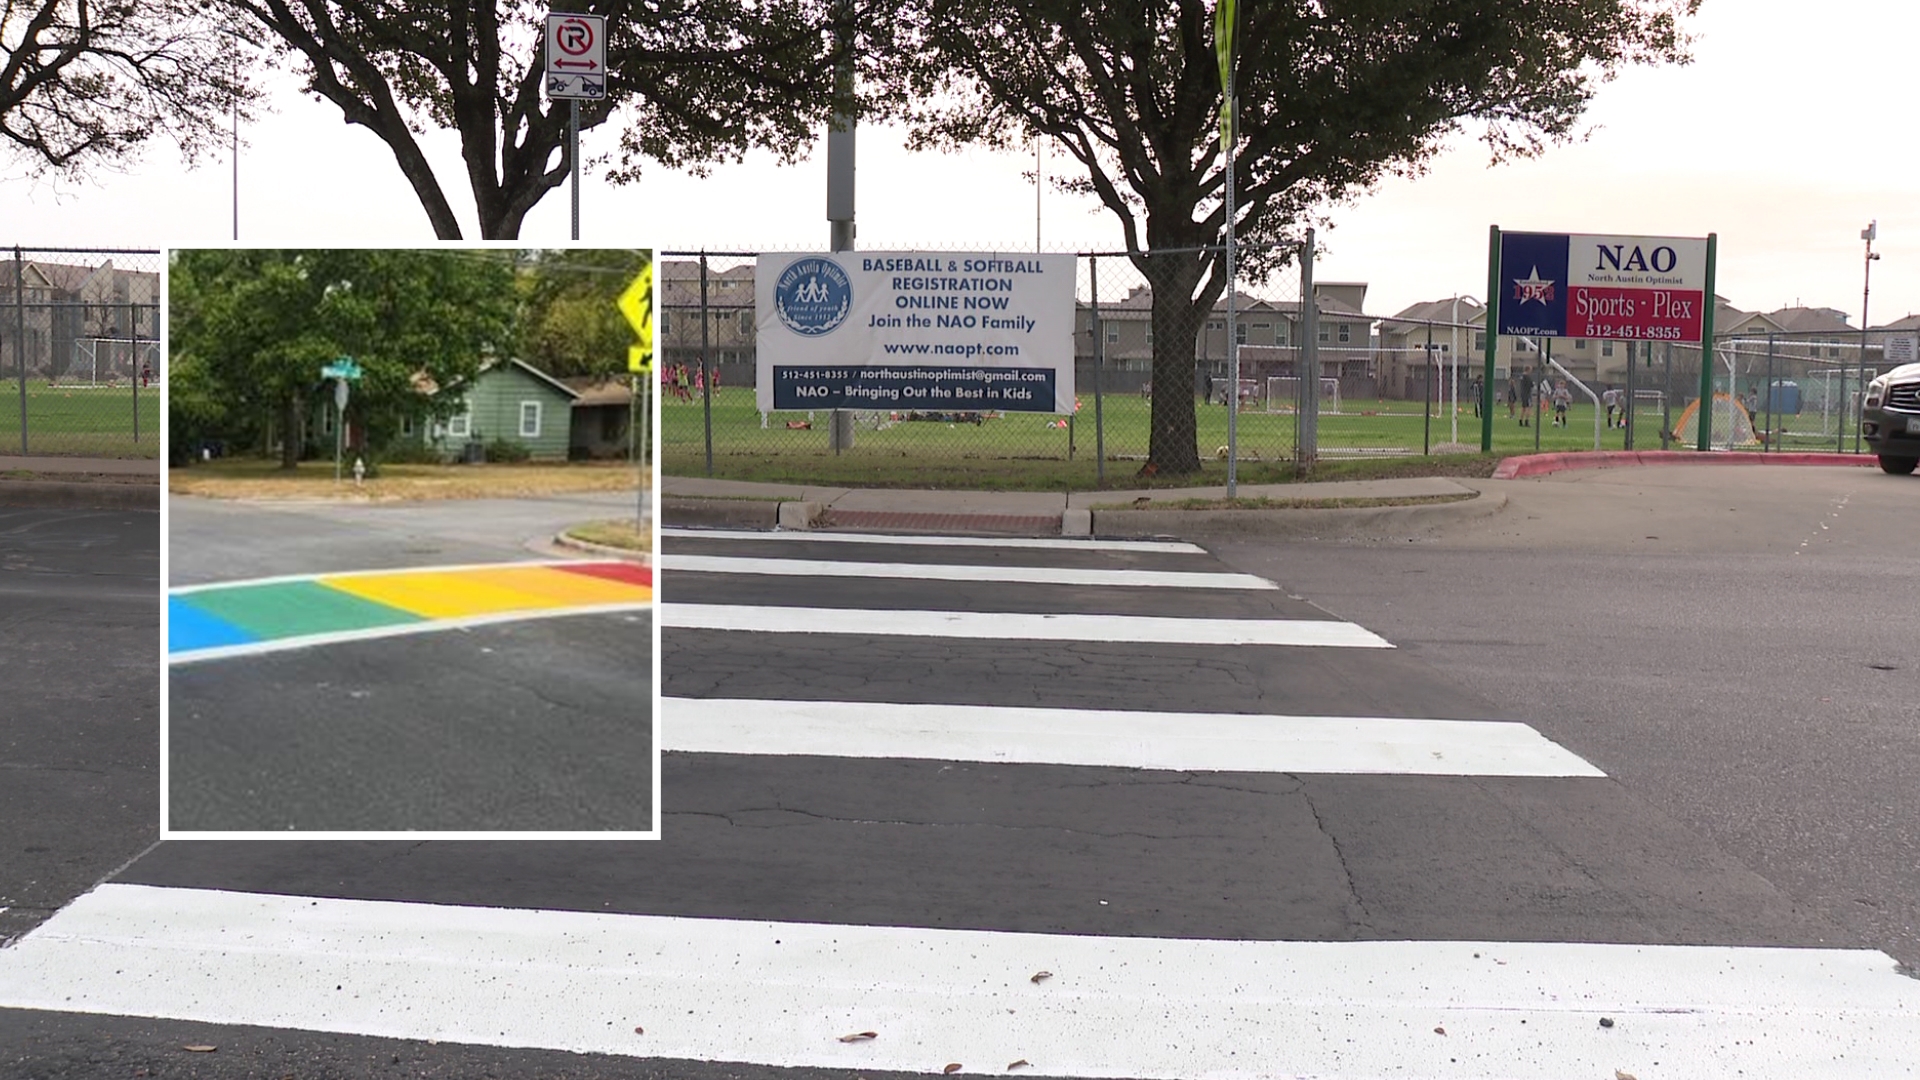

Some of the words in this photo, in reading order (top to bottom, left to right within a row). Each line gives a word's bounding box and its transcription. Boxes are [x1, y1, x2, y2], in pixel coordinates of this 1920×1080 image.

[863, 258, 942, 273] BASEBALL
[948, 260, 958, 272] &
[964, 260, 1043, 274] SOFTBALL
[1596, 244, 1676, 272] NAO
[778, 270, 798, 291] North
[796, 261, 820, 276] Austin
[822, 263, 848, 288] Optimist
[1588, 274, 1613, 282] North
[1615, 275, 1644, 284] Austin
[1646, 276, 1683, 285] Optimist
[892, 277, 1012, 292] REGISTRATION
[895, 296, 959, 310] ONLINE
[964, 296, 1010, 310] NOW
[1576, 288, 1634, 322] Sports
[1652, 291, 1692, 319] Plex
[868, 314, 902, 328] Join
[906, 314, 931, 328] the
[936, 315, 976, 328] NAO
[982, 315, 1035, 333] Family
[1506, 326, 1558, 336] NAOPT.com
[1586, 324, 1681, 340] 512-451-8355
[884, 342, 1019, 358] www.naopt.com
[782, 370, 848, 380] 512-451-8355
[852, 370, 858, 380] /
[860, 370, 1046, 384] northaustinoptimist@gmail.com
[796, 386, 829, 398] NAO
[844, 385, 900, 400] Bringing
[903, 386, 928, 398] Out
[931, 386, 952, 398] the
[956, 386, 983, 399] Best
[987, 386, 998, 399] in
[1002, 387, 1032, 400] Kids
